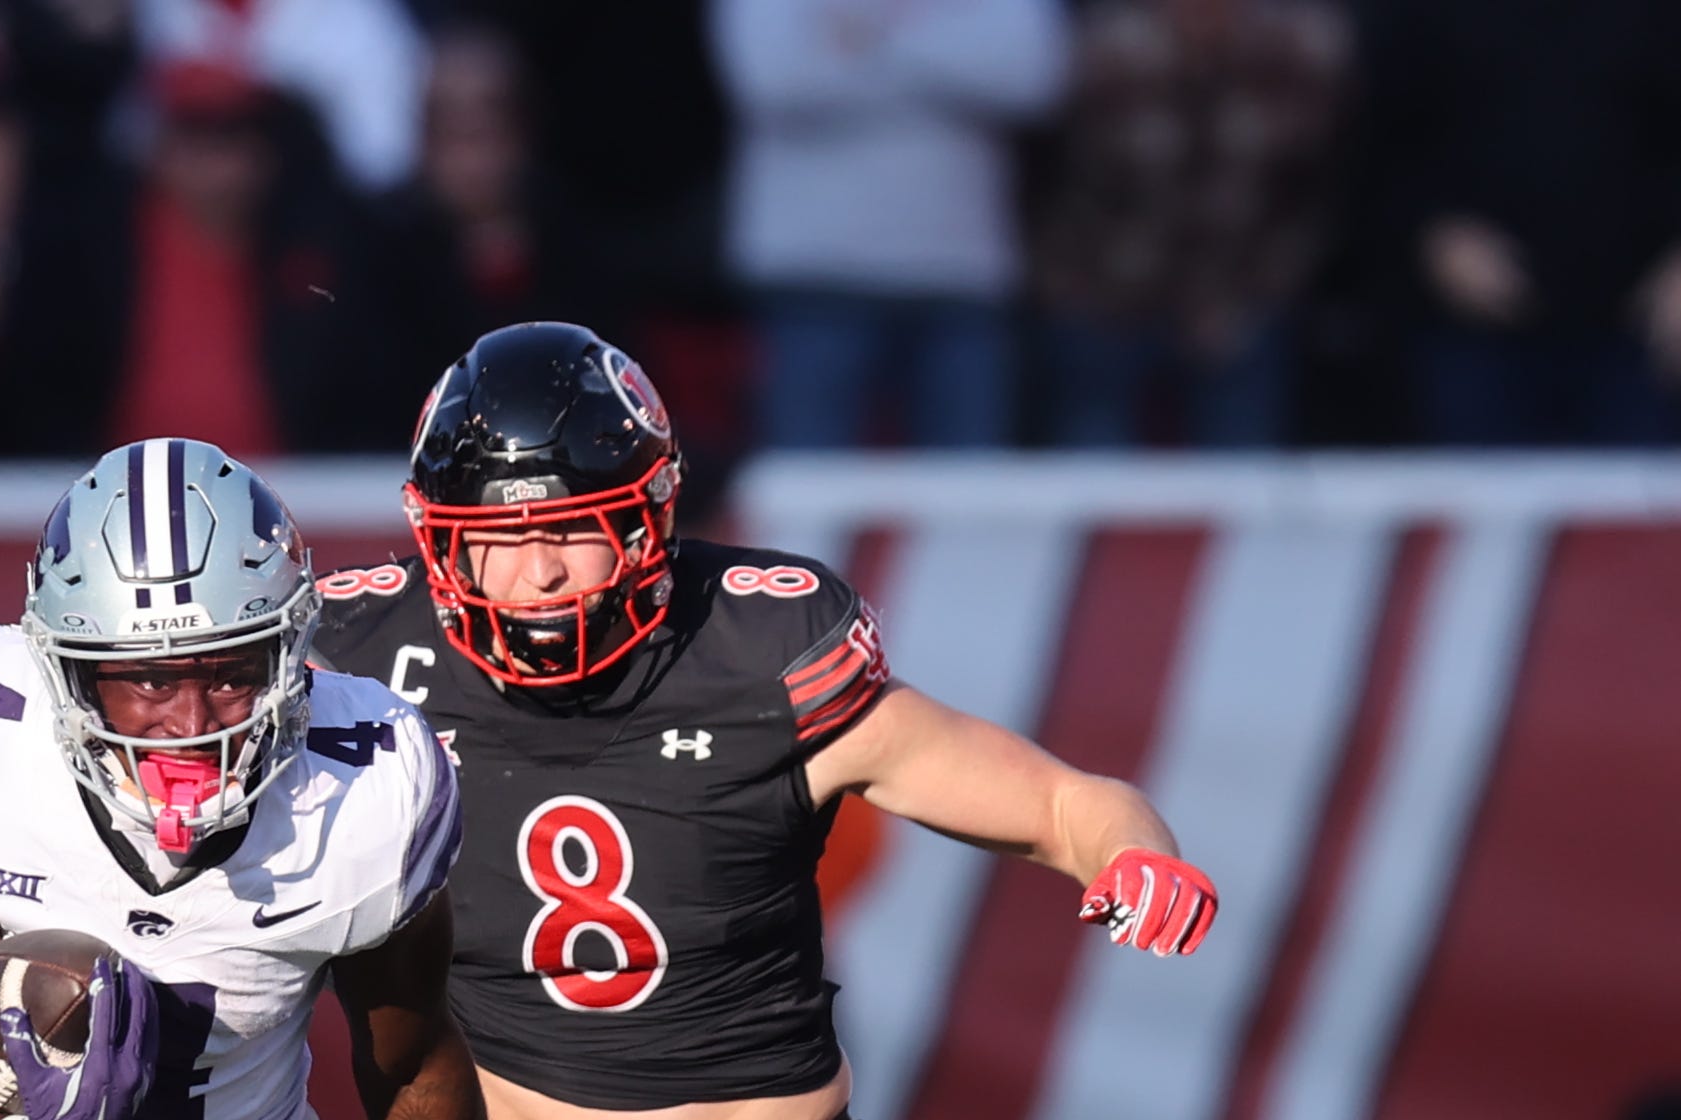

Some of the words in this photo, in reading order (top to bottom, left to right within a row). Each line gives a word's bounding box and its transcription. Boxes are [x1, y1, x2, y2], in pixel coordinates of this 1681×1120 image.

[315, 564, 408, 600] 8
[722, 566, 819, 597] 8
[131, 614, 200, 633] K-STATE
[389, 644, 436, 706] C
[306, 720, 397, 768] 4
[517, 794, 669, 1012] 8
